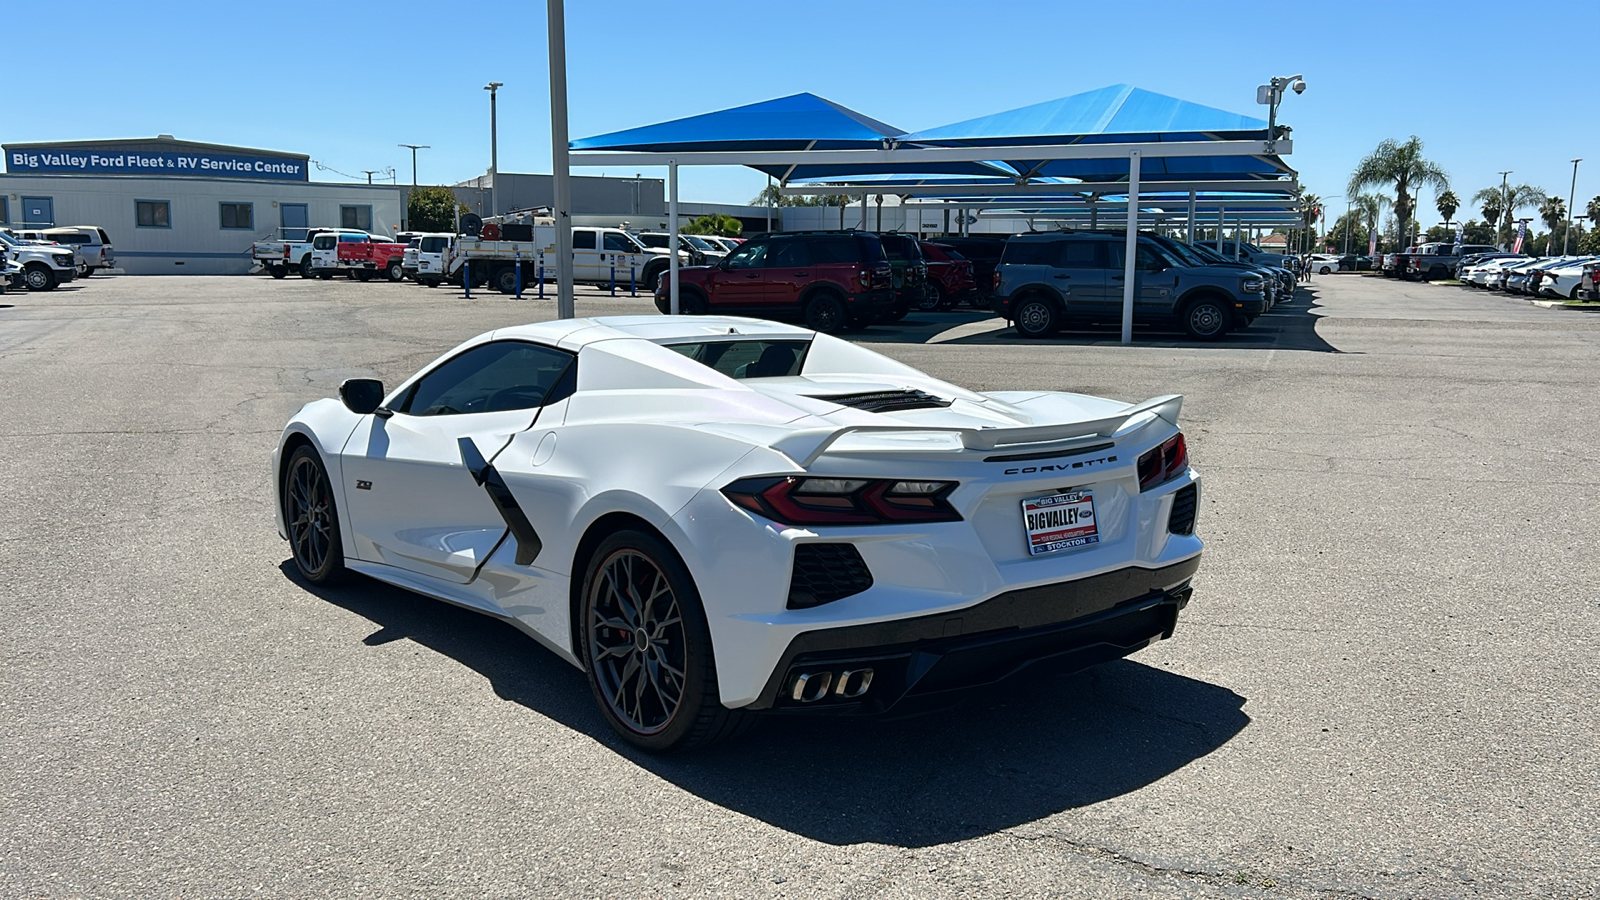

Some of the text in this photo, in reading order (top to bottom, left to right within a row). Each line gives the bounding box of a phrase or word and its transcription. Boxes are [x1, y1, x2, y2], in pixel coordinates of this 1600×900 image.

[13, 153, 300, 174] Big Valley Ford Fleet & RV Service Center
[1004, 455, 1118, 475] CORVETTE
[1054, 494, 1078, 503] VALLEY
[1028, 507, 1079, 530] BIGVALLEY
[1047, 538, 1086, 551] STOCKTON
